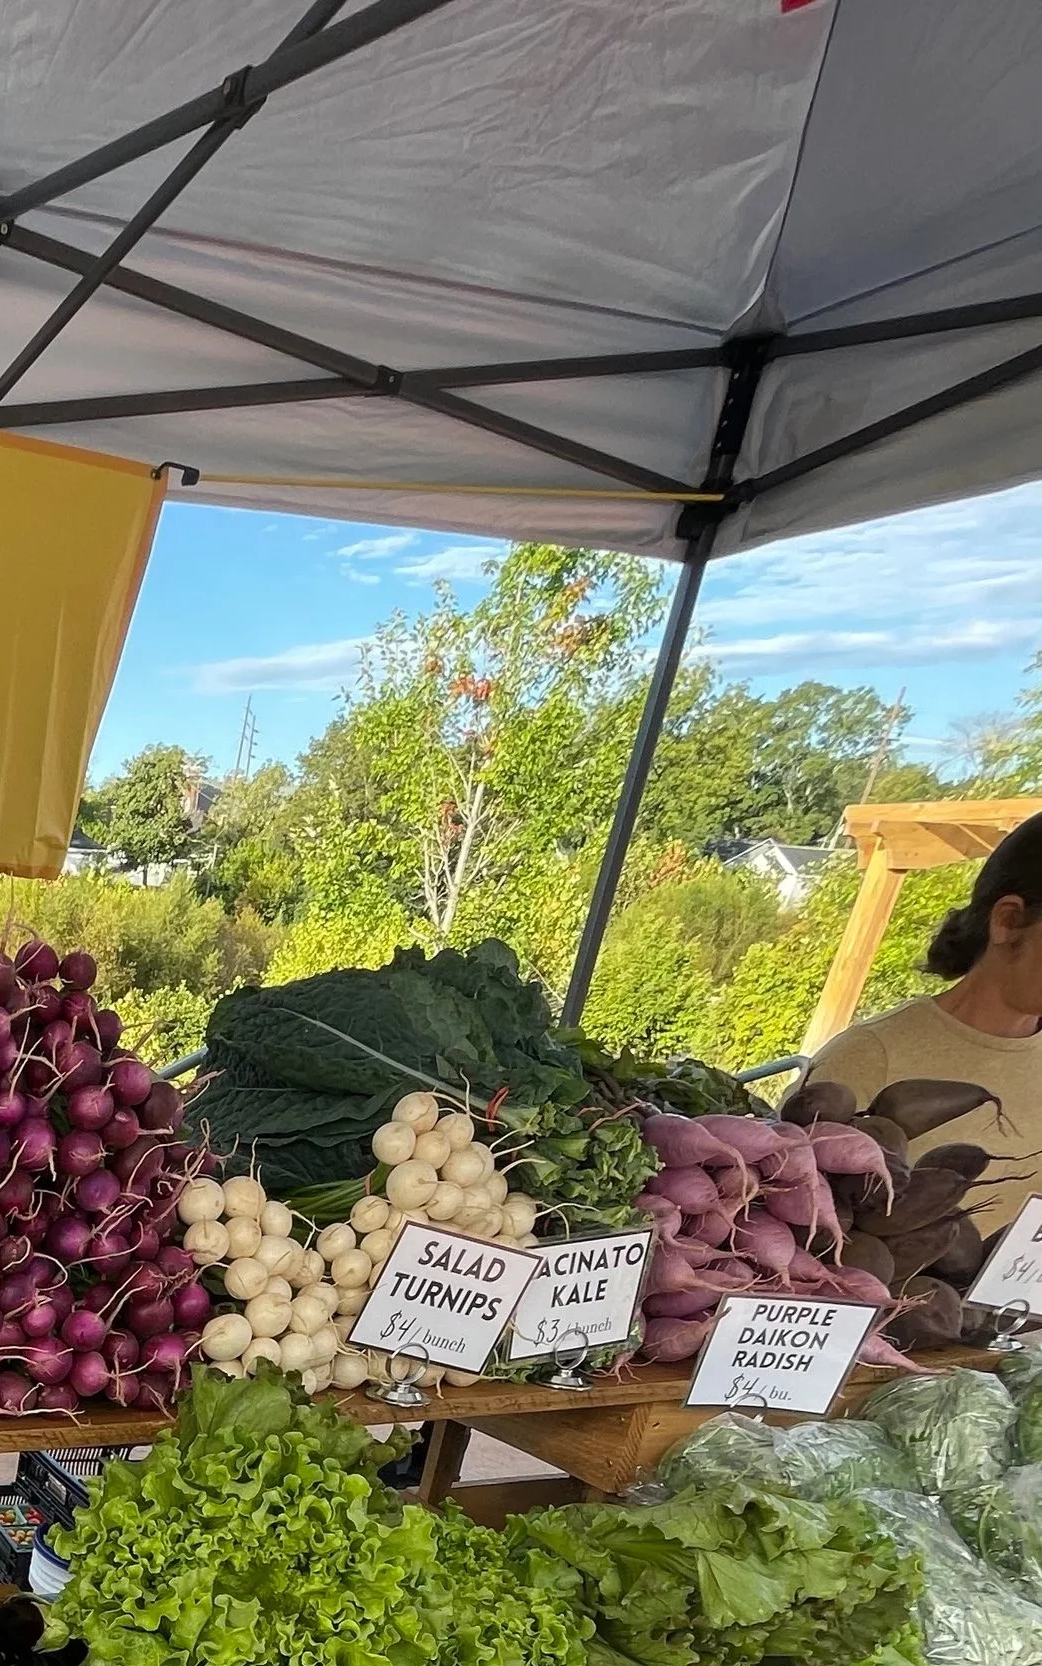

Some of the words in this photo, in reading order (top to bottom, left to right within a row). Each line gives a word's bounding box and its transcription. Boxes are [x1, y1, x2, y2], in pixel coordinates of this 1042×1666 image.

[417, 1240, 506, 1283] SALAD
[389, 1272, 502, 1321] TURNIPS
[551, 1278, 609, 1308] KALE
[751, 1304, 838, 1328] PURPLE
[380, 1310, 416, 1342] $4
[422, 1329, 466, 1354] bunch
[534, 1317, 560, 1347] $3
[574, 1318, 612, 1336] bunch
[737, 1327, 830, 1351] DAIKON
[731, 1350, 814, 1373] RADISH
[724, 1373, 757, 1402] $4
[769, 1384, 792, 1401] bu.
